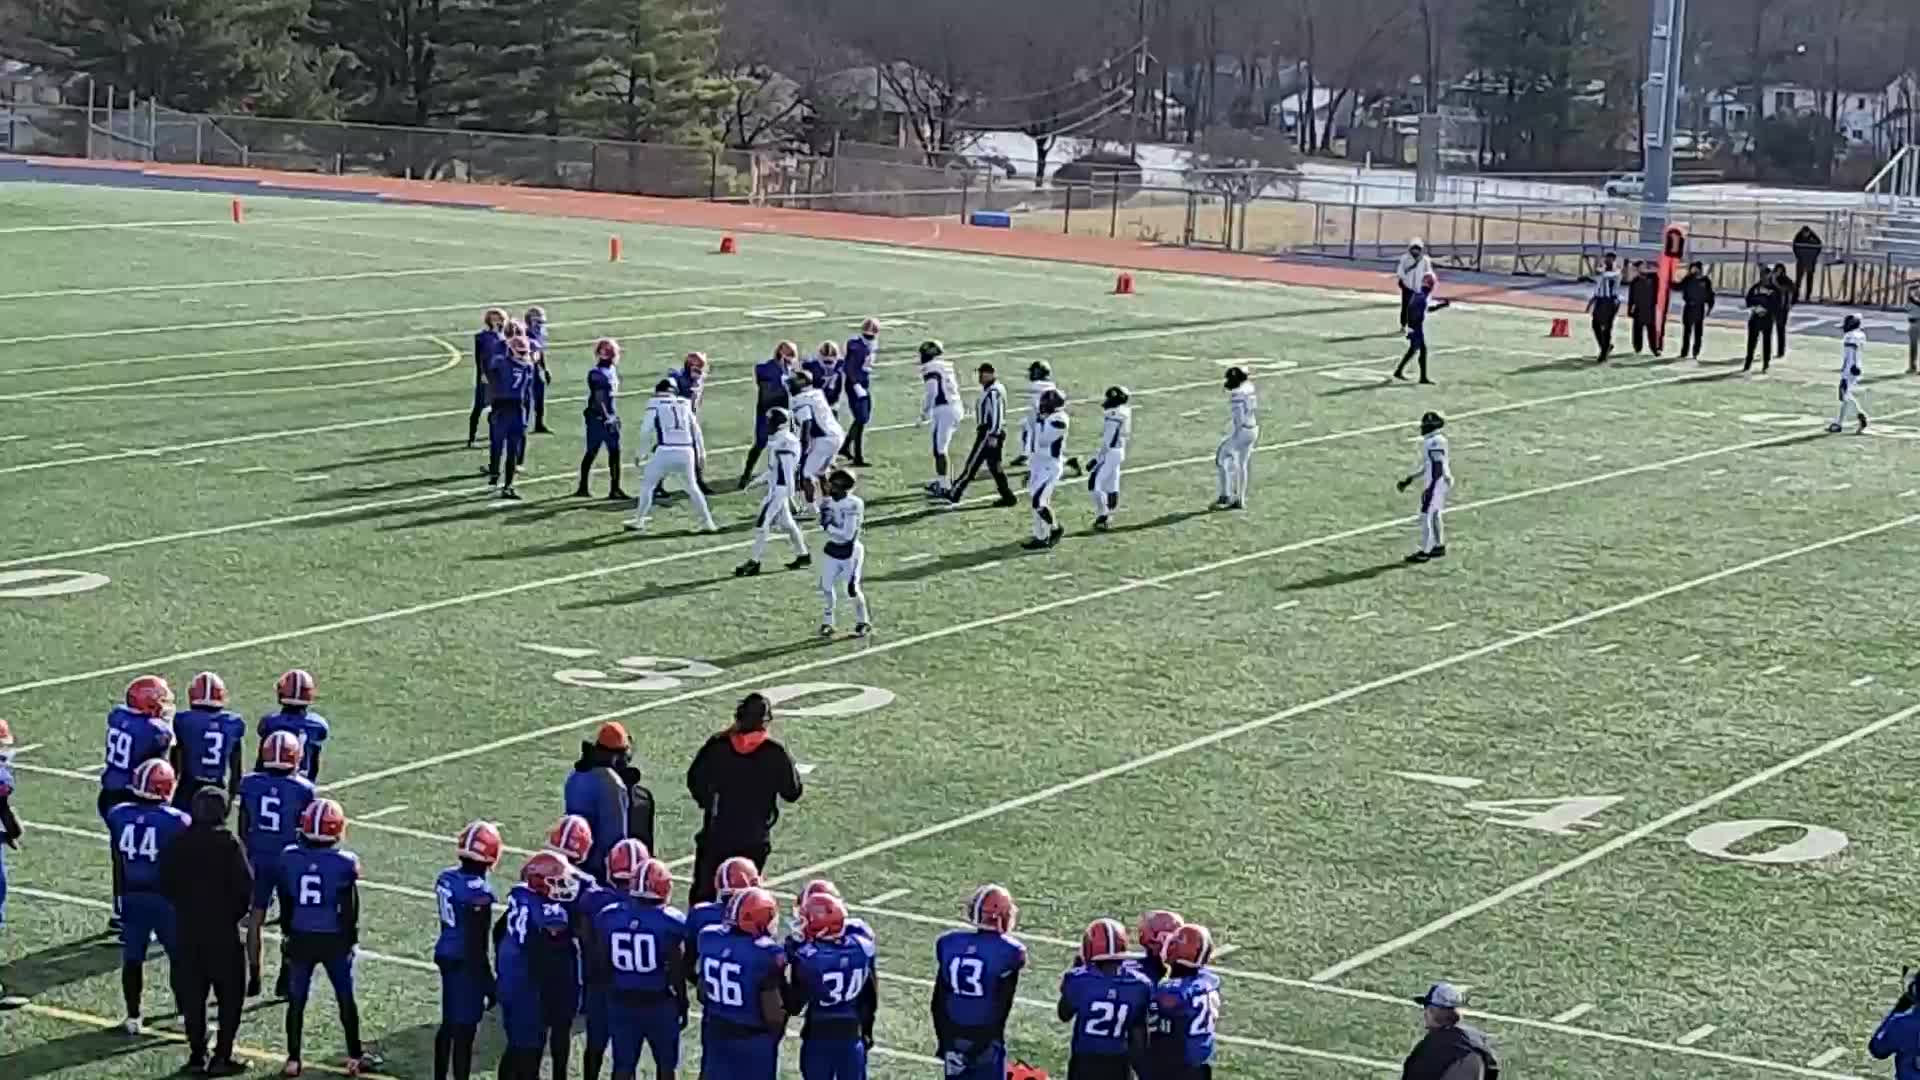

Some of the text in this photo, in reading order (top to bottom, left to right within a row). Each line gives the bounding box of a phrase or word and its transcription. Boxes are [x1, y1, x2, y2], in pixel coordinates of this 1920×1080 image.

[107, 728, 132, 769] 59
[201, 732, 223, 765] 3
[258, 796, 281, 832] 5
[118, 824, 158, 862] 44
[507, 895, 529, 944] 24
[611, 932, 656, 973] 60
[703, 958, 743, 1006] 56
[819, 968, 867, 1006] 34
[949, 957, 984, 996] 13
[1085, 1001, 1128, 1037] 21
